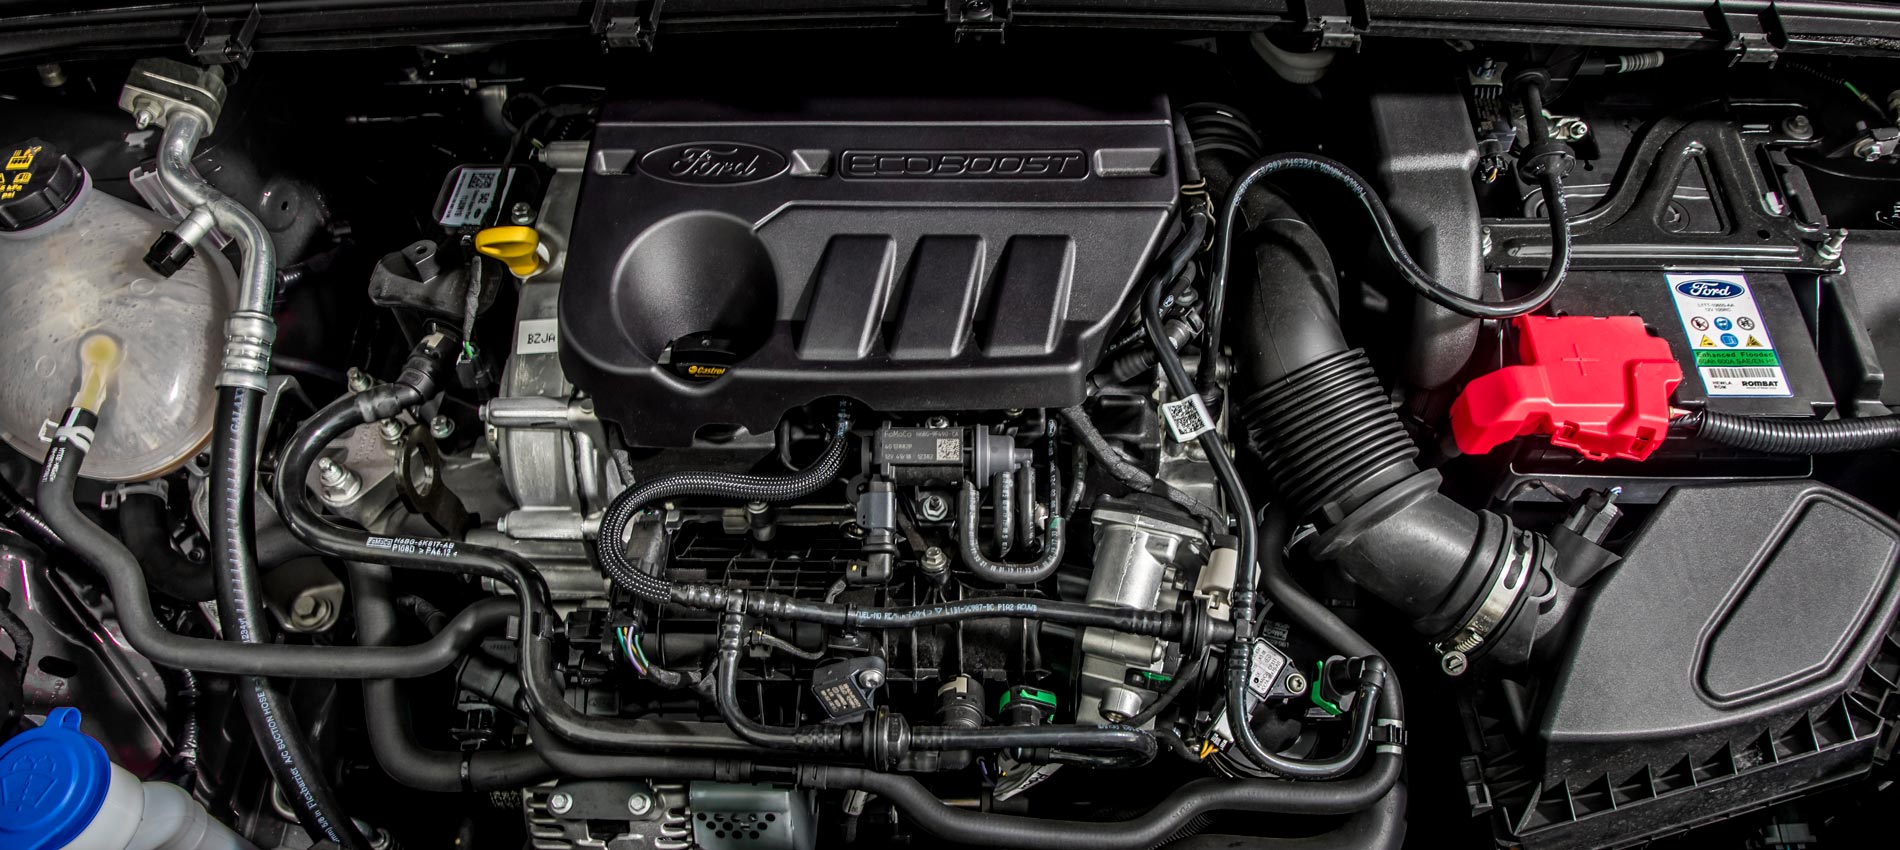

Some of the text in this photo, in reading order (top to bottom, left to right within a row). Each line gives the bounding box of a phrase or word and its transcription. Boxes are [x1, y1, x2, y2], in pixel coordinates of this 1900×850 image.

[669, 147, 1080, 177] Ford ECOBOOST
[1, 191, 16, 200] psi
[1689, 282, 1731, 296] Ford
[527, 332, 556, 345] BZJA
[697, 366, 726, 375] Castrol
[256, 691, 272, 715] HOSE
[266, 715, 286, 750] SUCTION
[290, 767, 317, 810] Flexbarrier
